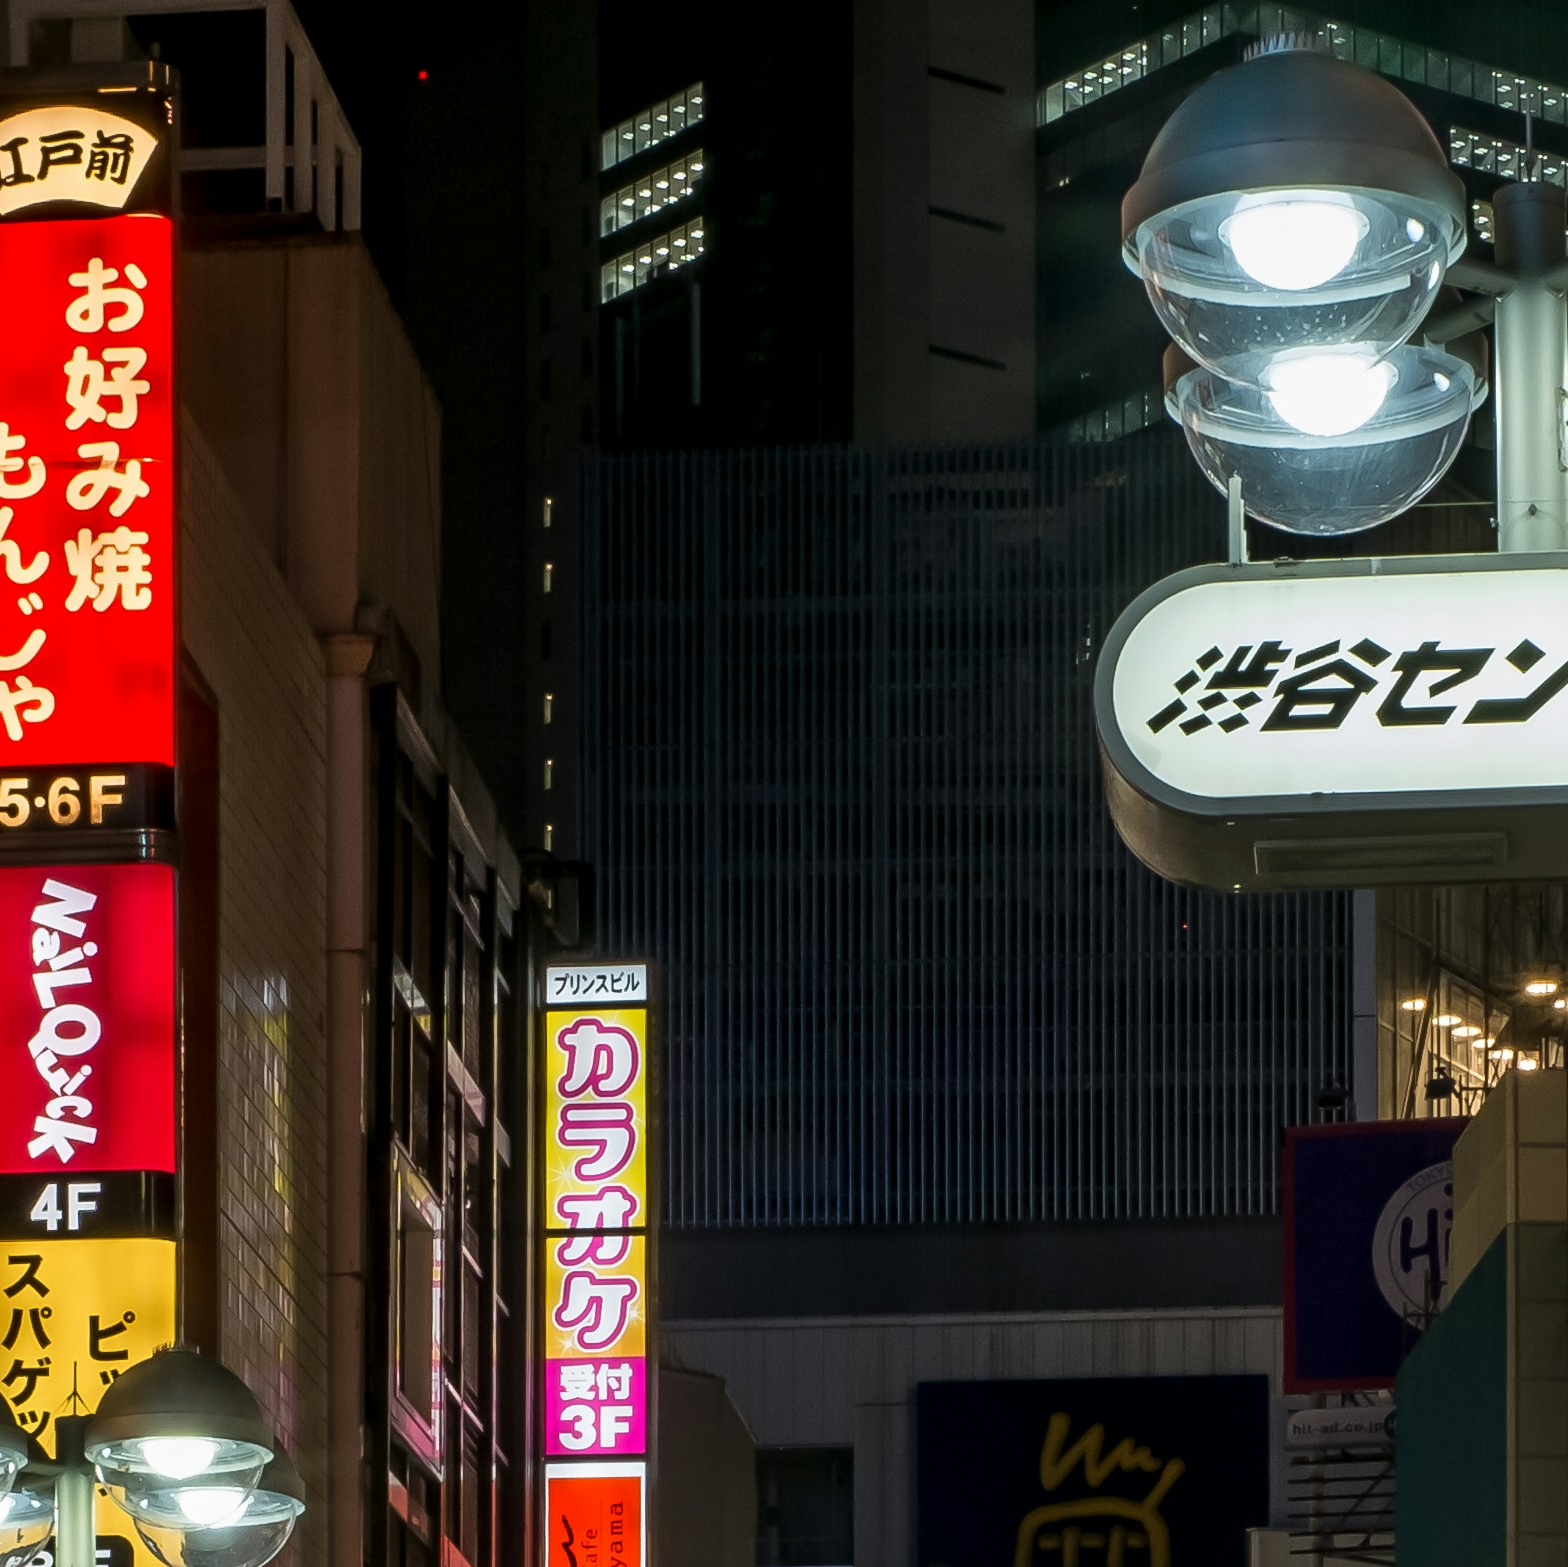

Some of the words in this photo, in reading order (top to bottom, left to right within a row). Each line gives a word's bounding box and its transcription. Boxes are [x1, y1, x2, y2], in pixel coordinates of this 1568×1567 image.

[65, 258, 151, 614] お好み焼
[553, 972, 640, 996] プリンスビル
[31, 1183, 101, 1231] 4F
[556, 1018, 639, 1349] カラオケ
[1, 1255, 52, 1441] スパゲッ
[559, 1363, 633, 1401] 受付
[559, 1405, 633, 1450] 3F
